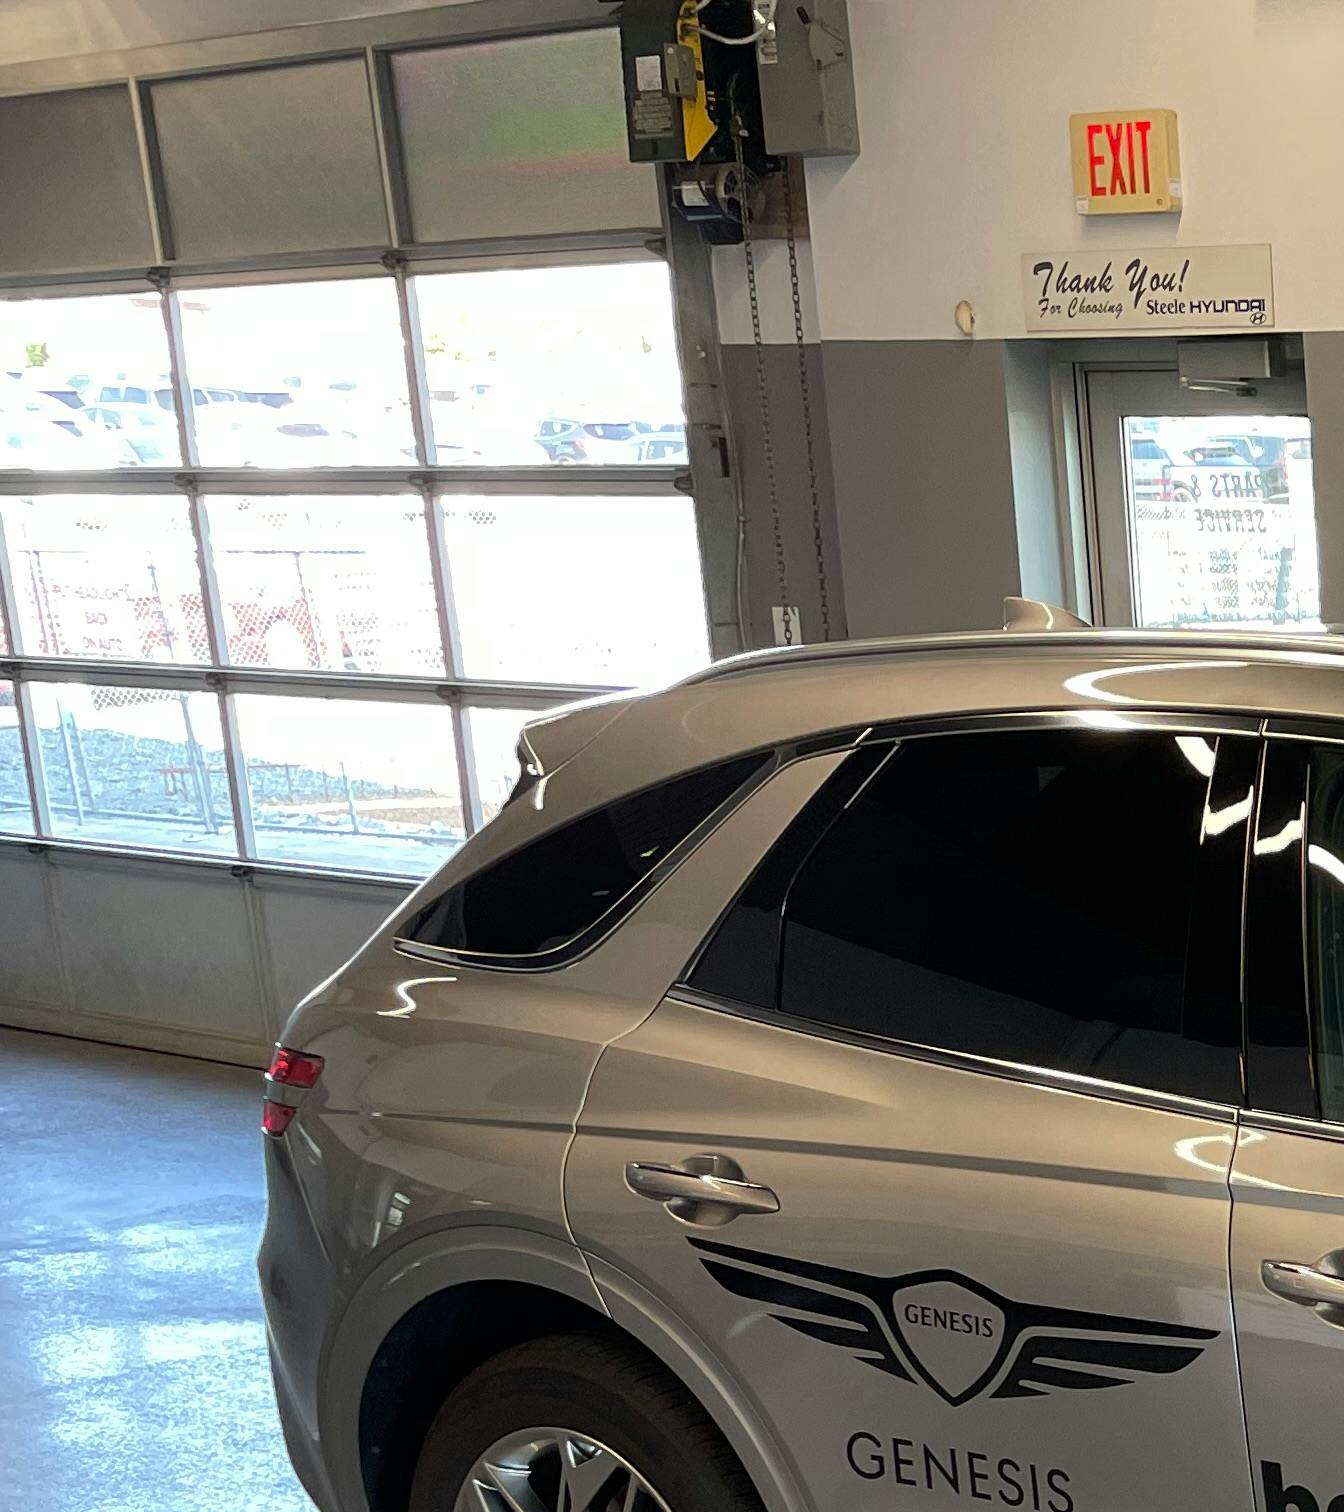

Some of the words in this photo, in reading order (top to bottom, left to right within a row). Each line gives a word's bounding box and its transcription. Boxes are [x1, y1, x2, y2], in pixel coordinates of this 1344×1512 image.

[1087, 121, 1151, 197] EXIT
[1033, 261, 1113, 298] Thank
[1125, 258, 1190, 309] You!
[1038, 298, 1062, 318] For
[1067, 296, 1124, 319] Choosing
[1146, 299, 1186, 314] Steele
[1189, 298, 1265, 314] HYUNDAI
[904, 1303, 994, 1339] GENESIS
